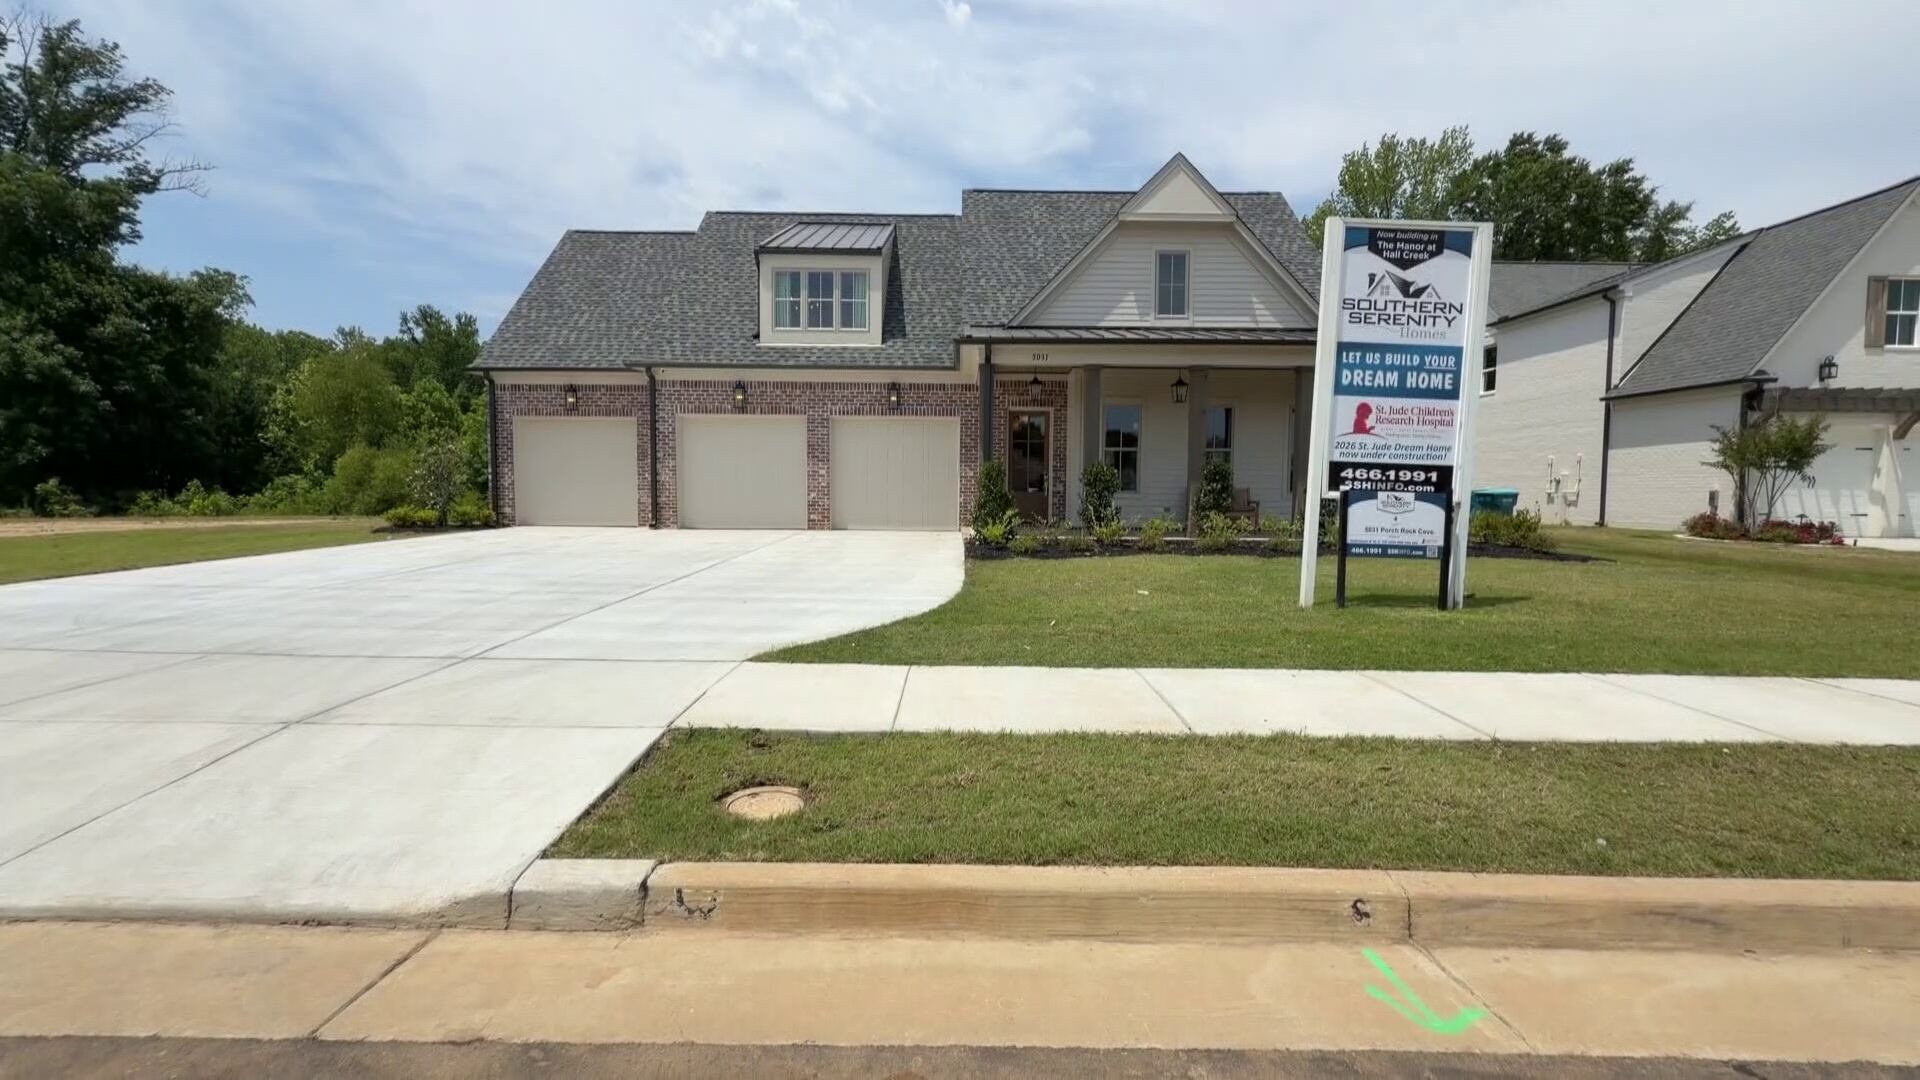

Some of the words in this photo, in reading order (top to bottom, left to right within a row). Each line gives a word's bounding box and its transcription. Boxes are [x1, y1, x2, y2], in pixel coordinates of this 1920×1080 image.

[1376, 230, 1396, 238] Now
[1396, 231, 1429, 241] building
[1430, 232, 1438, 240] in
[1377, 241, 1394, 249] The
[1397, 241, 1424, 251] Manor
[1427, 243, 1436, 252] at
[1383, 250, 1400, 259] Hall
[1402, 251, 1429, 260] Creek
[1342, 298, 1463, 315] SOUTHERN
[1348, 312, 1457, 328] SERENITY
[1400, 327, 1446, 340] Homes
[1342, 351, 1360, 364] LET
[1366, 352, 1380, 364] US
[1385, 353, 1420, 366] BUILD
[1424, 355, 1456, 368] YOUR
[1342, 369, 1398, 387] DREAM
[1406, 371, 1454, 390] HOME
[1375, 405, 1386, 415] St.
[1389, 406, 1409, 416] Jude
[1411, 406, 1455, 418] Children's
[1375, 415, 1414, 425] Research
[1416, 416, 1454, 429] Hospital
[1335, 441, 1356, 450] 2026
[1358, 442, 1369, 450] St.
[1371, 442, 1392, 451] Jude
[1394, 443, 1424, 452] Dream
[1426, 443, 1452, 453] Home
[1339, 451, 1357, 459] now
[1361, 451, 1386, 459] under
[1388, 452, 1447, 461] construction!
[1340, 468, 1438, 482] 466.1991
